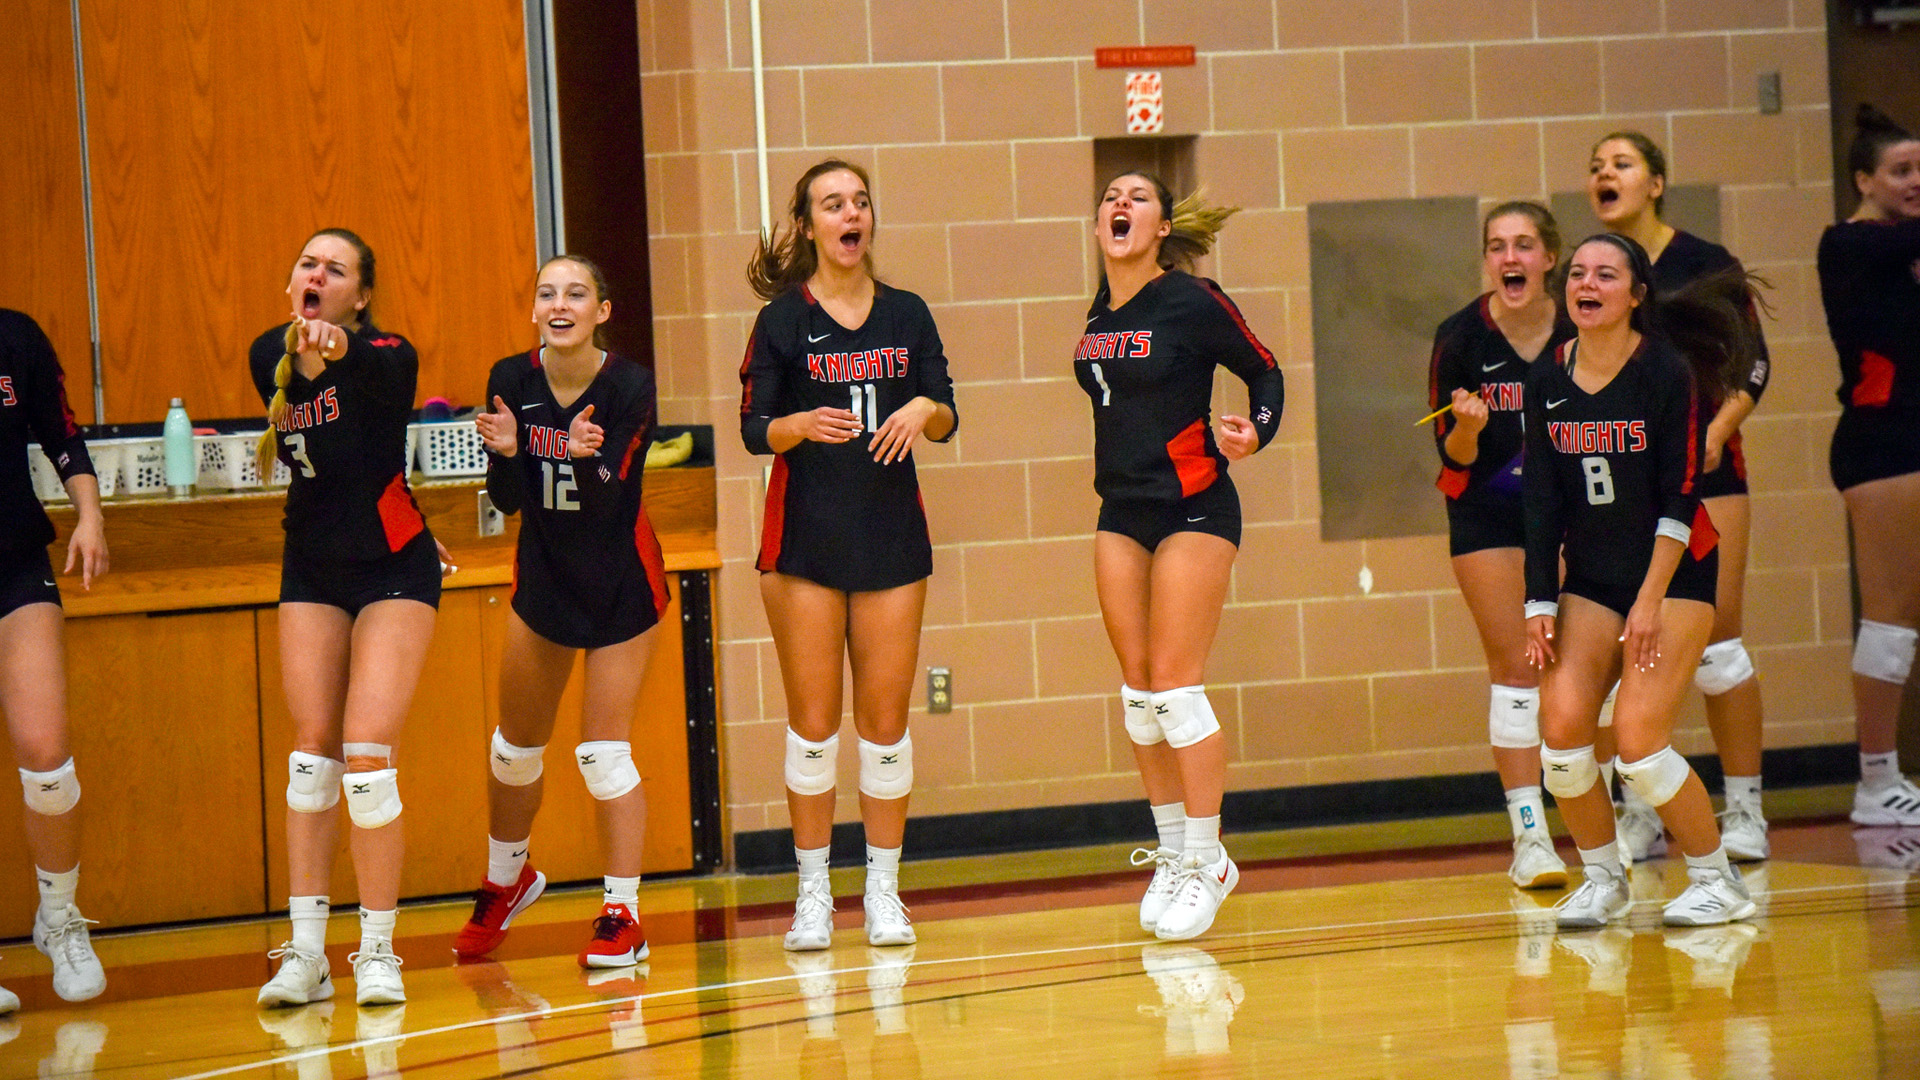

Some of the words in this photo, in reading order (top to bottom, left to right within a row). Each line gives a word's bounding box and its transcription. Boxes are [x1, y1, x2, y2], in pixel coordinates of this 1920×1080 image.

[1134, 80, 1155, 96] FIRE
[807, 347, 910, 383] KNIGHTS
[1073, 330, 1153, 361] NIGHTS
[1091, 363, 1111, 406] 1
[849, 383, 878, 433] 11
[284, 433, 317, 478] 3
[1547, 420, 1647, 454] KNIGHTS
[541, 461, 581, 511] 12
[1581, 456, 1616, 505] 8
